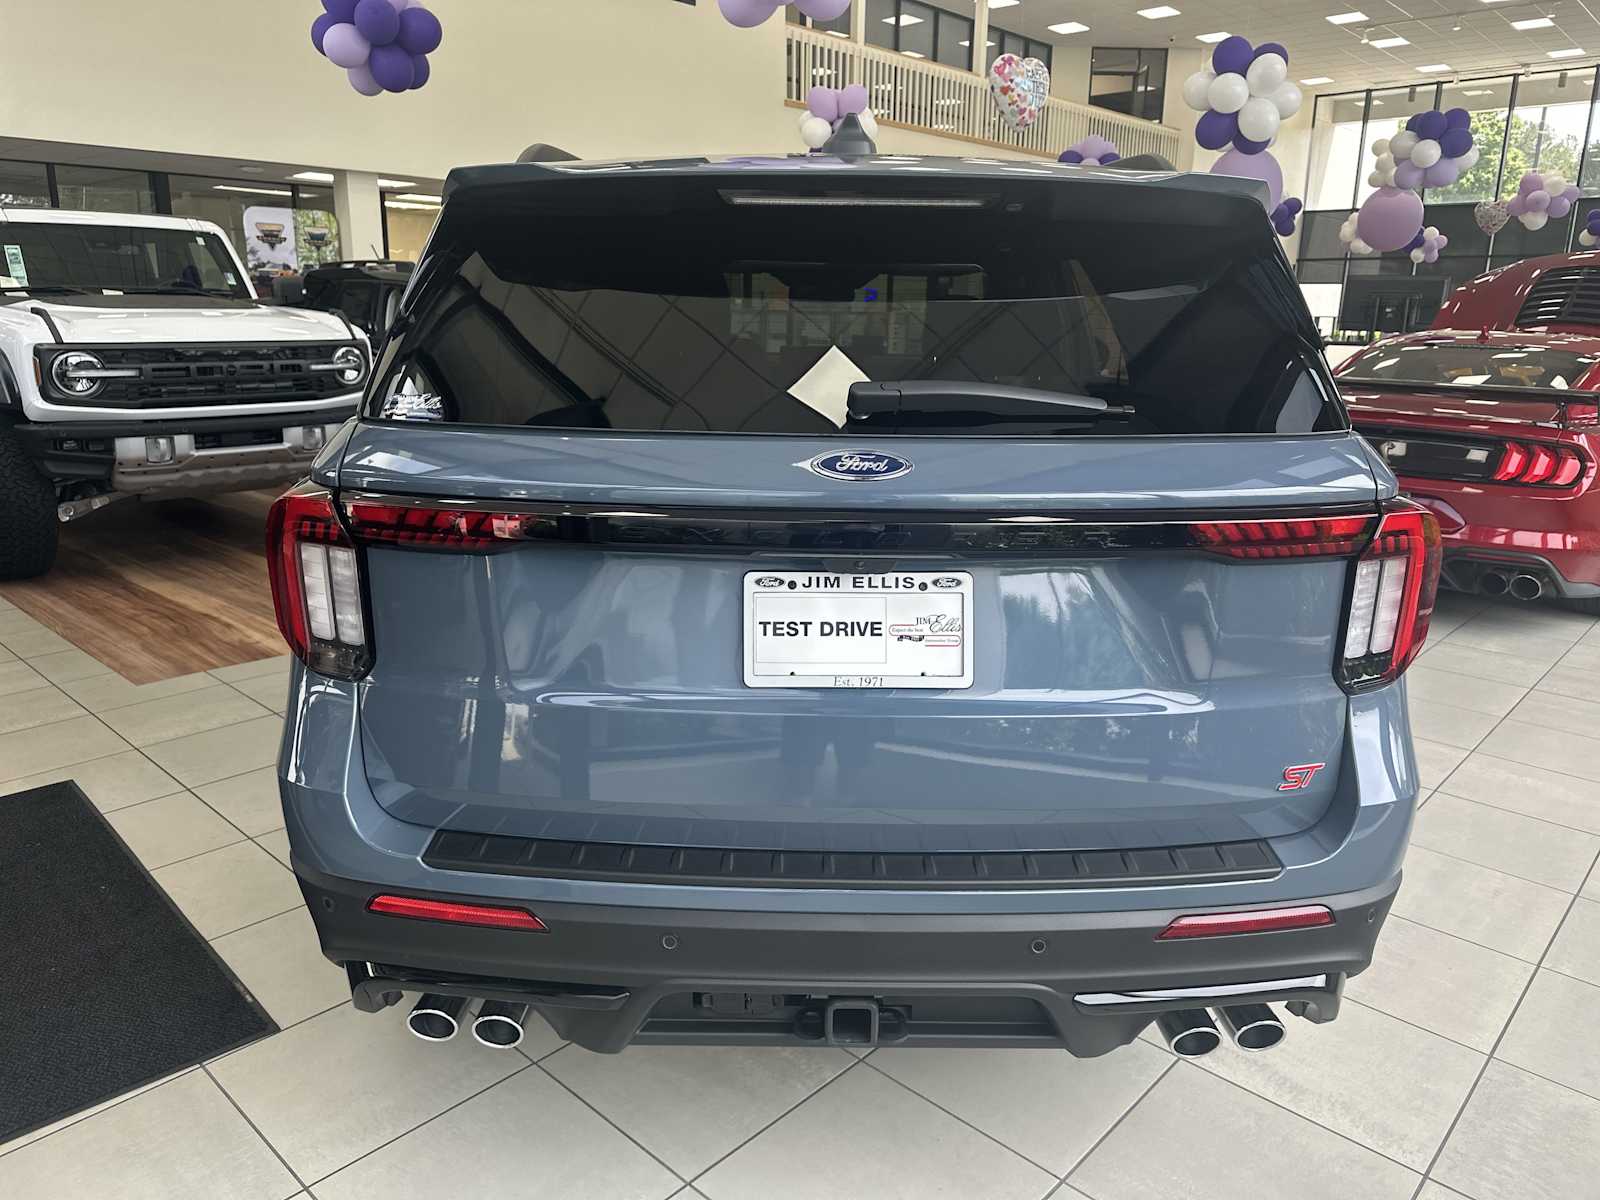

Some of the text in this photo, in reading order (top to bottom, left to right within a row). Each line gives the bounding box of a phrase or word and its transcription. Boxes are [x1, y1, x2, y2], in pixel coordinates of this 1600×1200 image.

[835, 453, 889, 473] Ford
[802, 576, 915, 589] JIM ELLIS
[758, 621, 882, 636] TEST DRIVE
[915, 614, 961, 633] JIM Ellis
[834, 676, 884, 687] Est. 1971
[1278, 762, 1326, 791] ST
